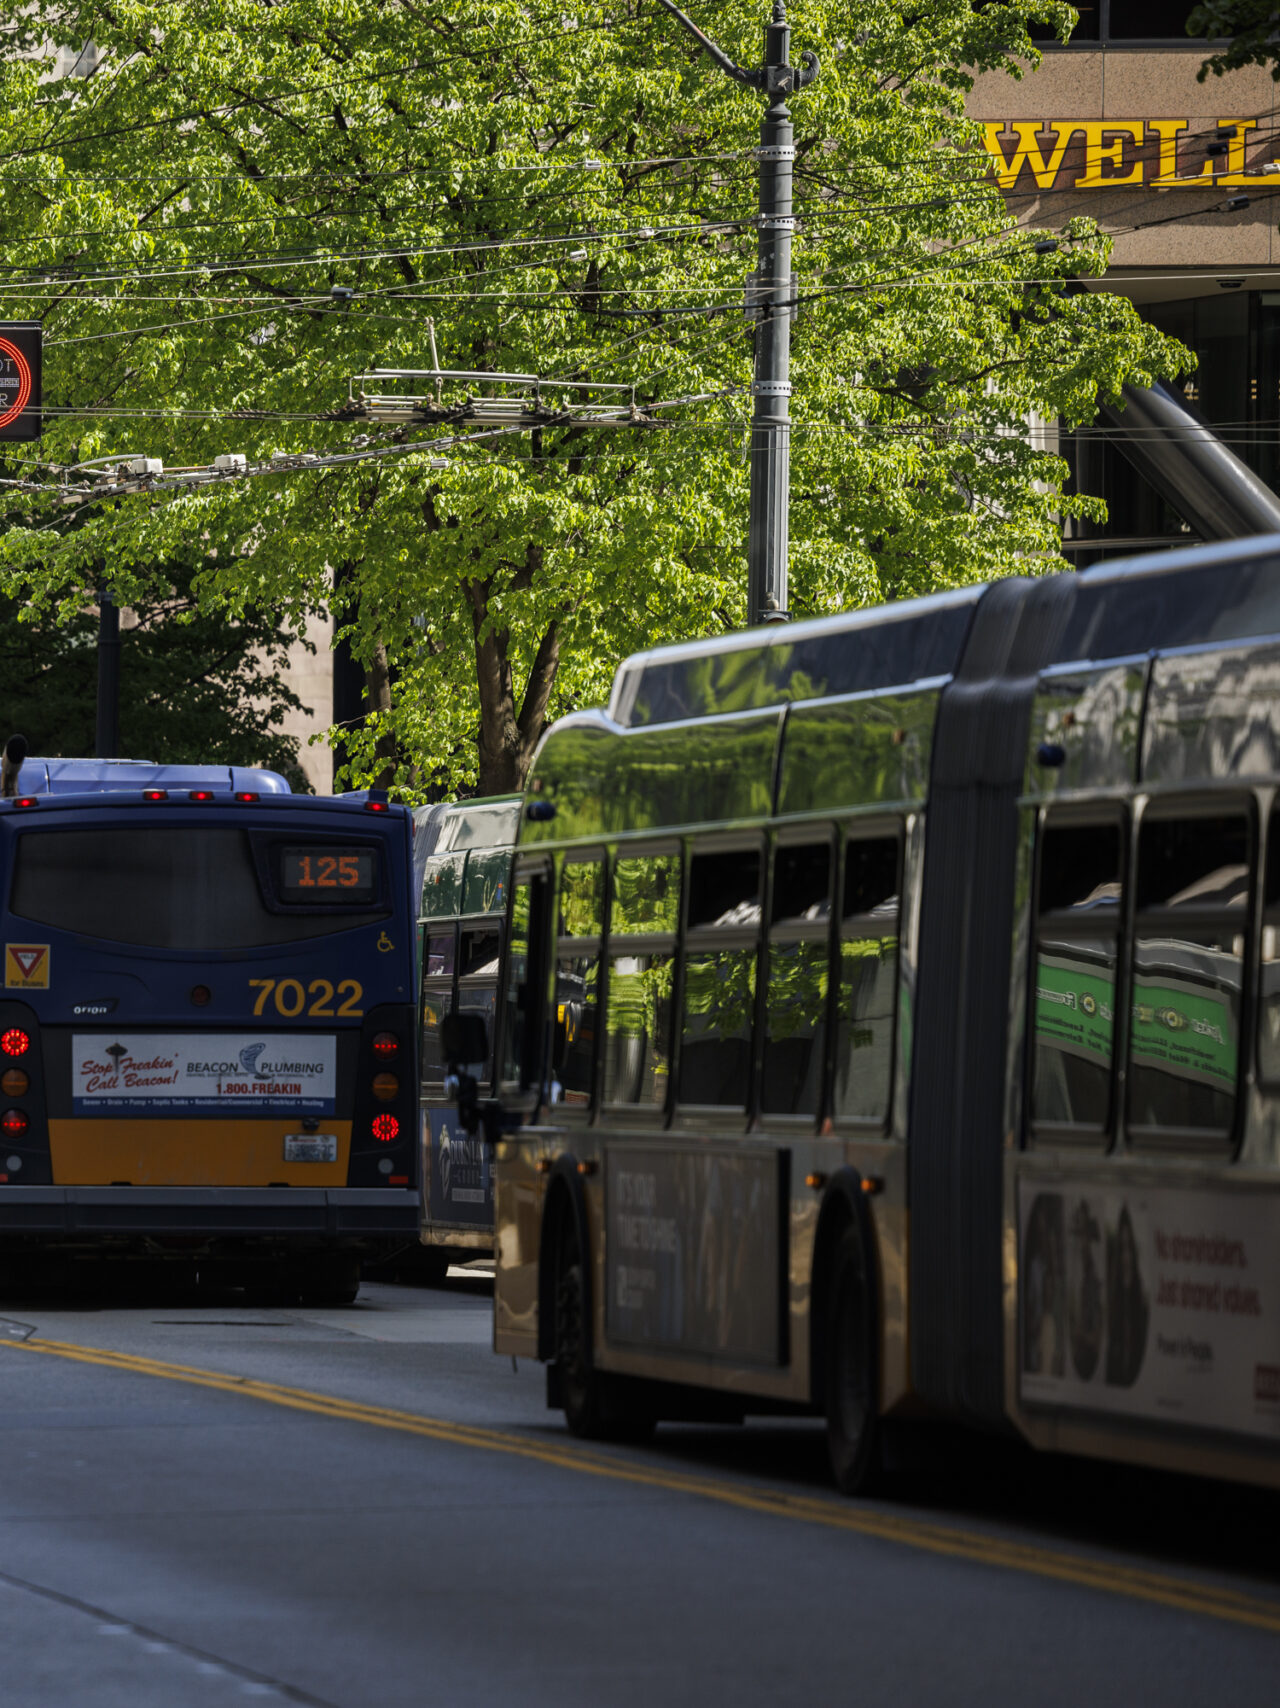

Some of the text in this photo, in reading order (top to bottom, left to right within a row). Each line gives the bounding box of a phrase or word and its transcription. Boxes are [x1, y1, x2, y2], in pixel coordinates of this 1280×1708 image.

[298, 856, 359, 886] 125
[249, 978, 363, 1017] 7022
[80, 1060, 113, 1076] Stop
[186, 1062, 325, 1074] BEACON PLUMBING
[86, 1070, 179, 1093] Call Beacon!
[216, 1082, 302, 1095] 1.800.FREAKIN
